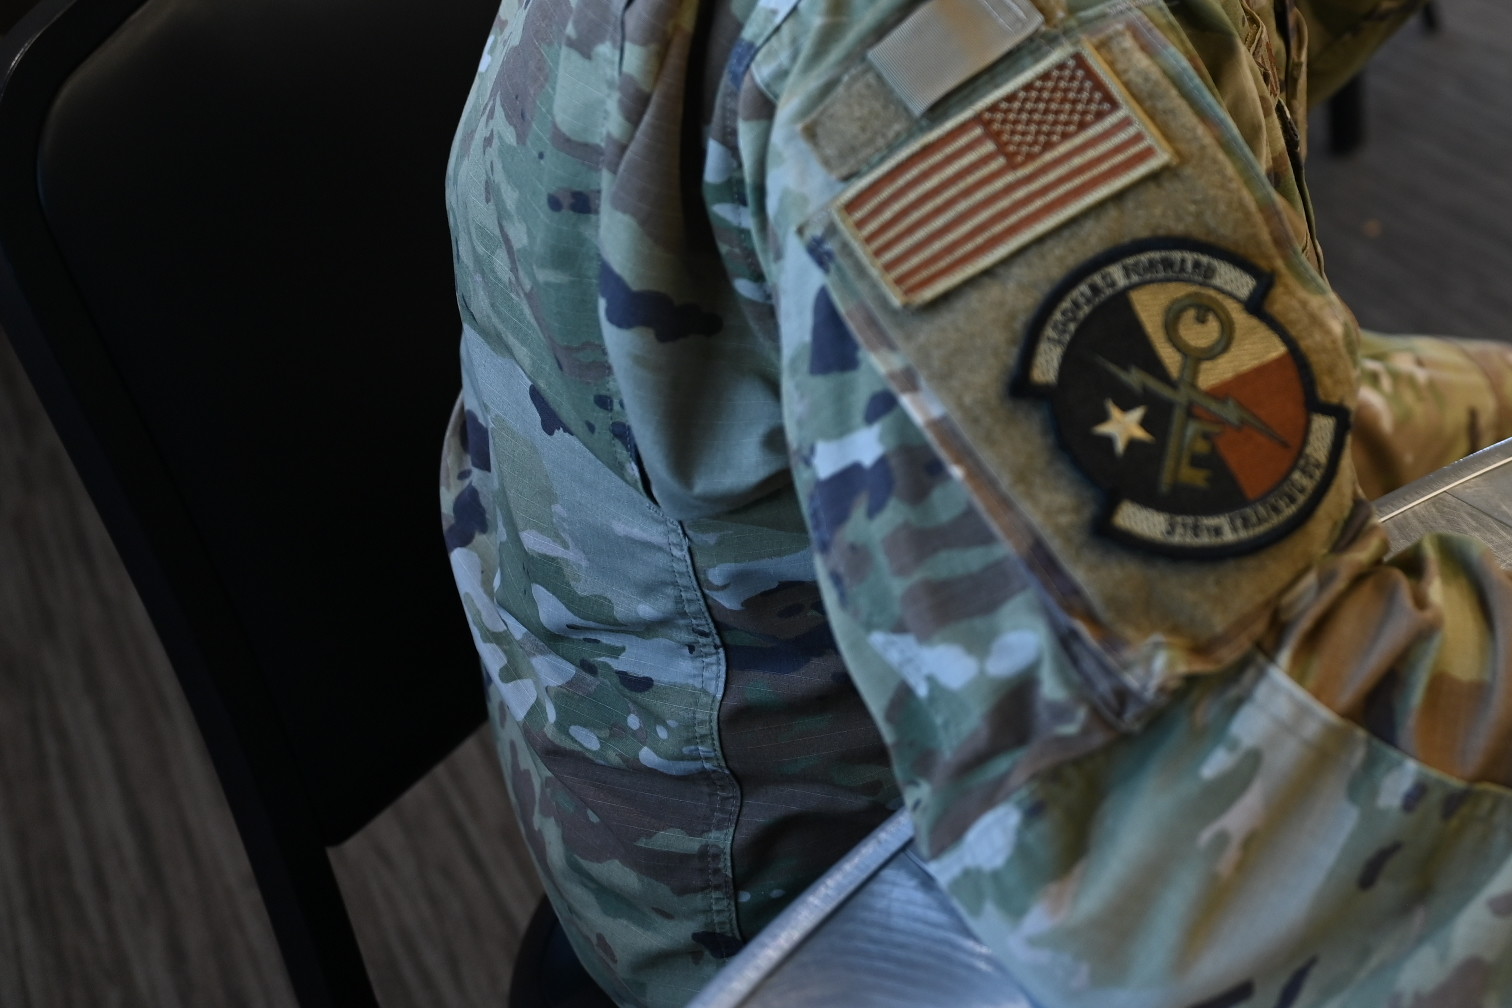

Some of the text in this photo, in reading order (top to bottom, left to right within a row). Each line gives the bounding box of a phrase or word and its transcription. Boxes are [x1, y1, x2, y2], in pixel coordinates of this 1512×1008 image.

[1049, 254, 1218, 346] LOOKING FORWARD
[1227, 475, 1310, 534] TRAINING
